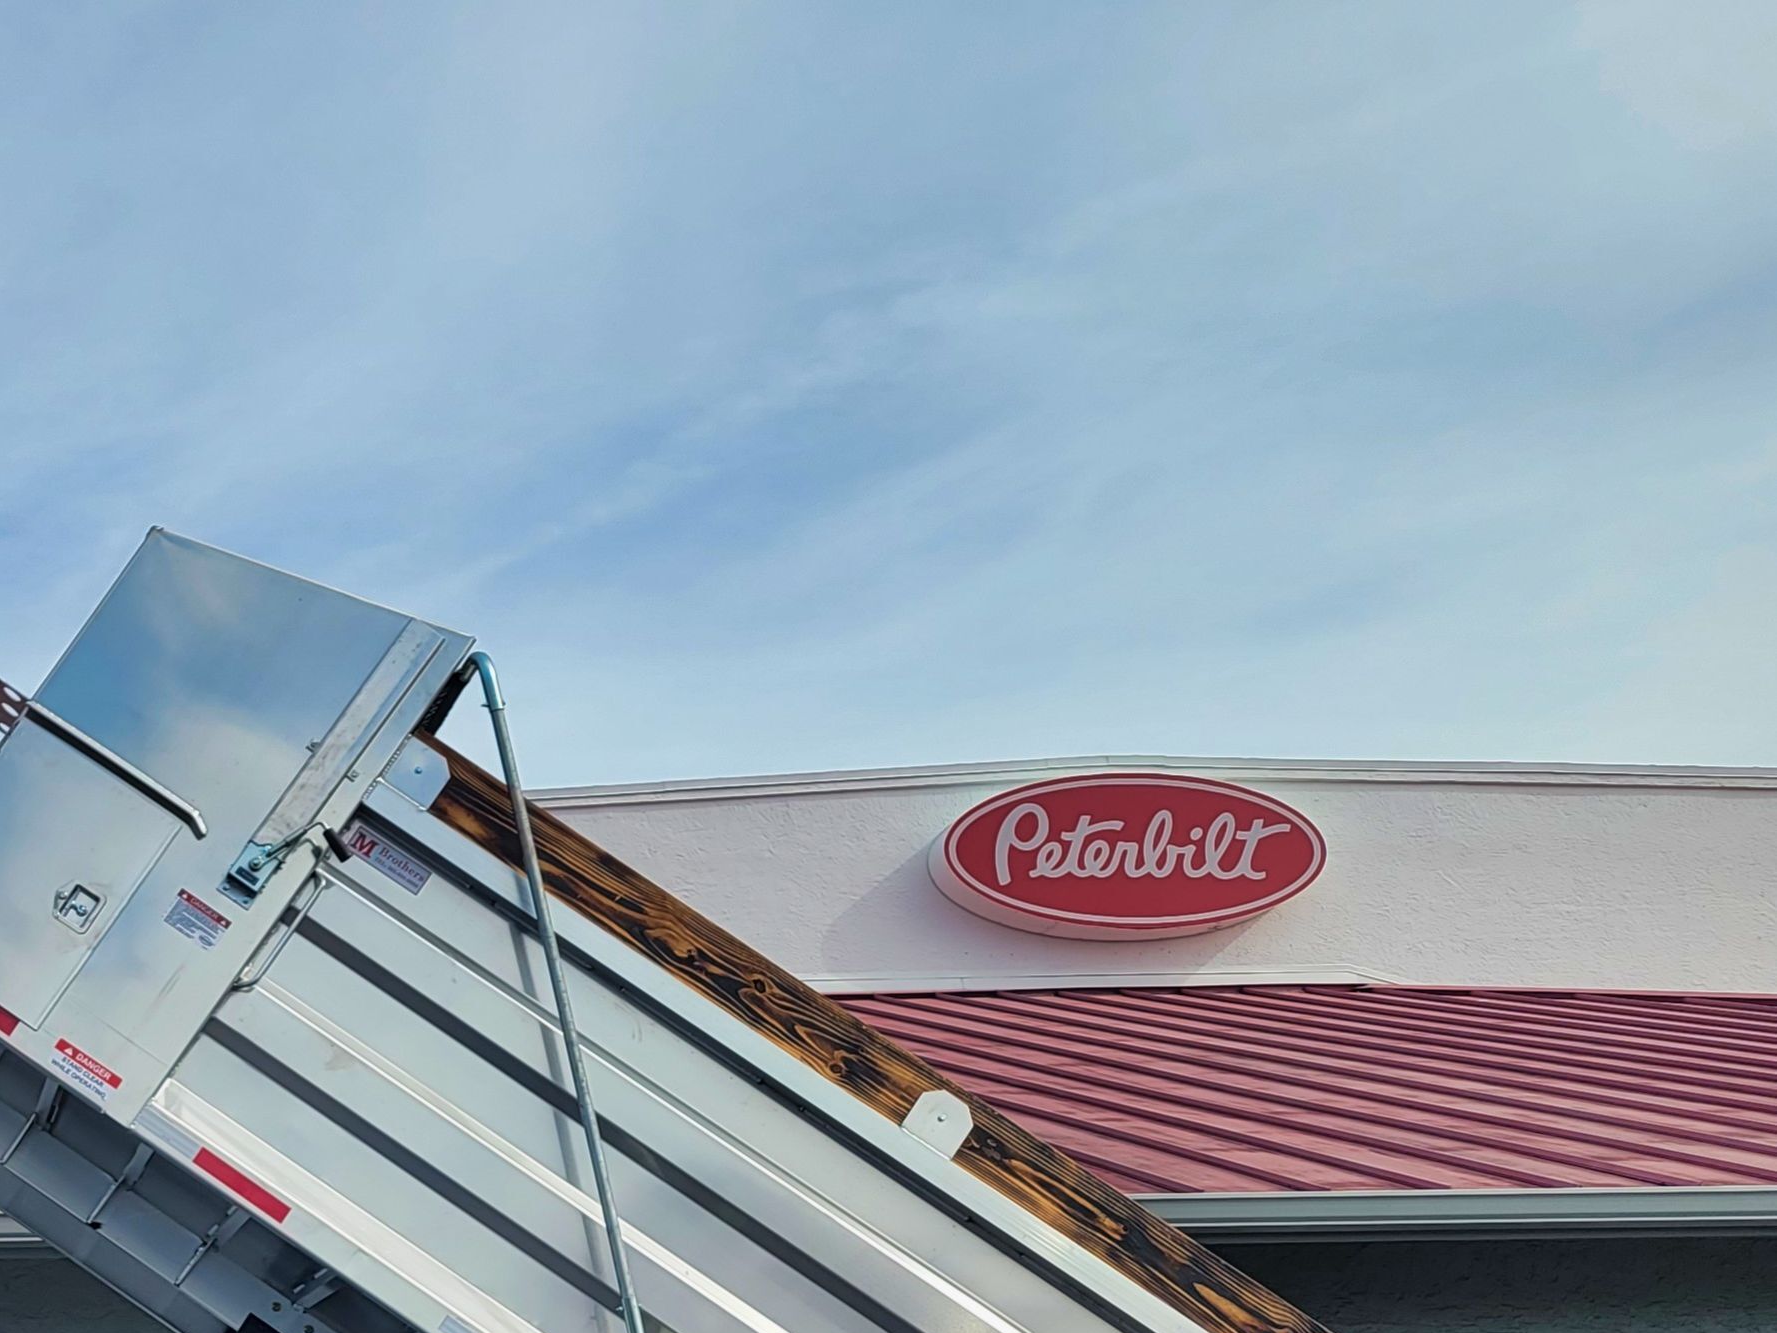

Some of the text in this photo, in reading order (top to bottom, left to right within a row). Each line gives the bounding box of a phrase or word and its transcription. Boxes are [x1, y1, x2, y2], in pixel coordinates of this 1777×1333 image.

[350, 831, 379, 858] M
[995, 803, 1291, 886] Peterbilt
[61, 1056, 104, 1087] STAND CLEAR
[75, 1053, 112, 1080] DANGER
